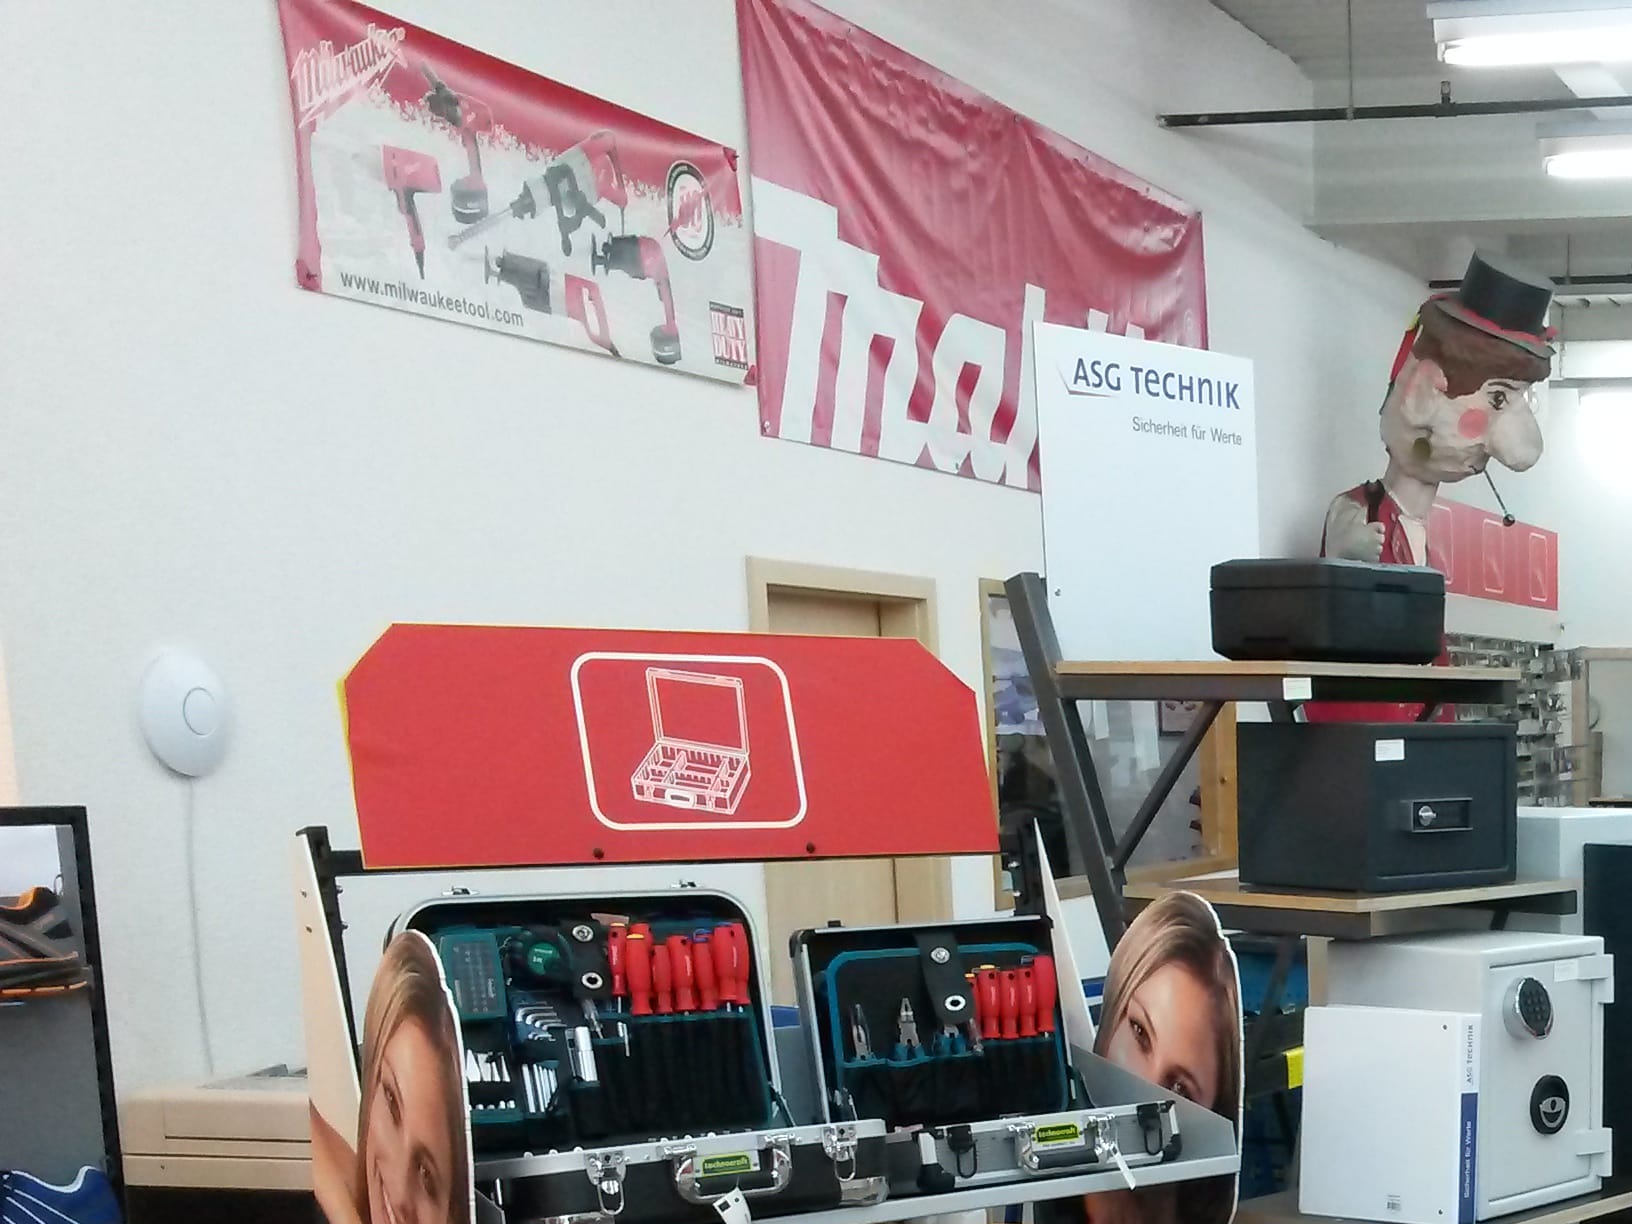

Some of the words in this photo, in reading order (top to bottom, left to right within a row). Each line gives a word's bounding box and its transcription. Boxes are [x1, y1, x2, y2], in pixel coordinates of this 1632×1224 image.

[340, 271, 525, 327] www.milwaukeetool.com
[713, 335, 747, 362] DUTY
[1073, 357, 1121, 392] ASG
[1132, 416, 1188, 439] Sicherheit
[1191, 424, 1207, 441] für
[1210, 427, 1243, 446] Werte
